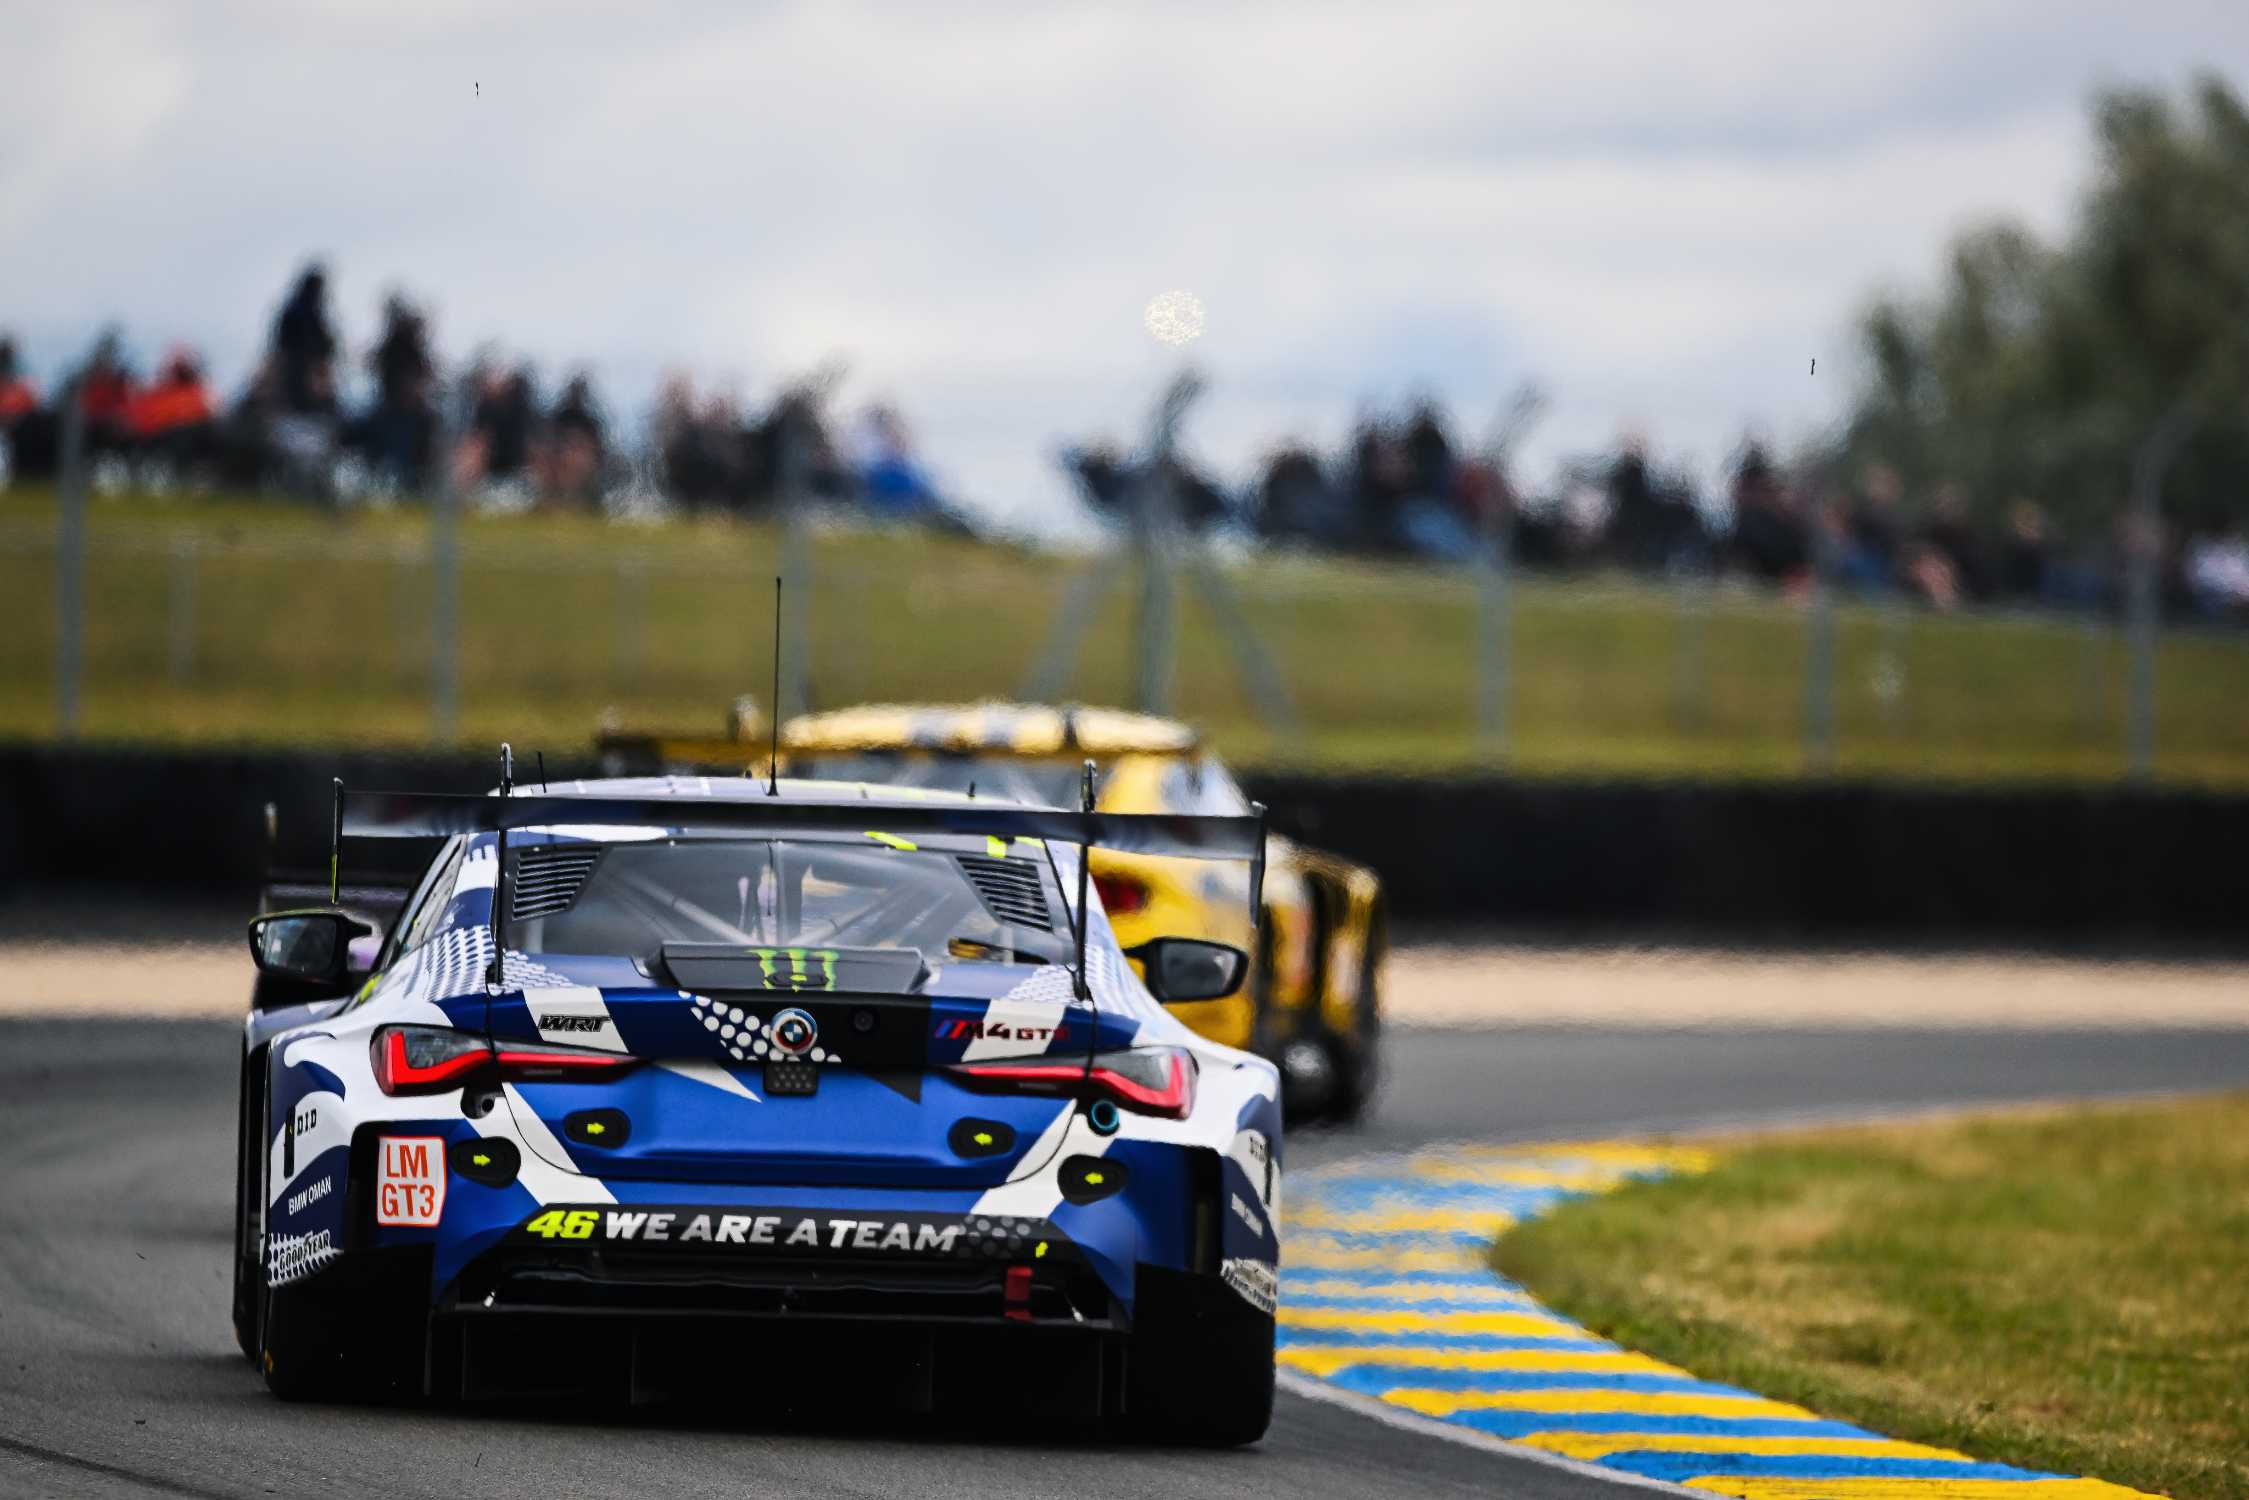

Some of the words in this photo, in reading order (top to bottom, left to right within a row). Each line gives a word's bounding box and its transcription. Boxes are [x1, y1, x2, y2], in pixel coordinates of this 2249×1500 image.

[538, 1015, 611, 1032] WRT
[386, 1144, 428, 1178] LM
[288, 1192, 307, 1216] BMW
[308, 1175, 332, 1204] OMAN
[382, 1183, 435, 1217] GT3
[526, 1210, 600, 1239] 46
[606, 1211, 676, 1240] WE
[679, 1214, 781, 1243] ARE
[785, 1218, 818, 1246] A
[829, 1219, 960, 1251] TEAM
